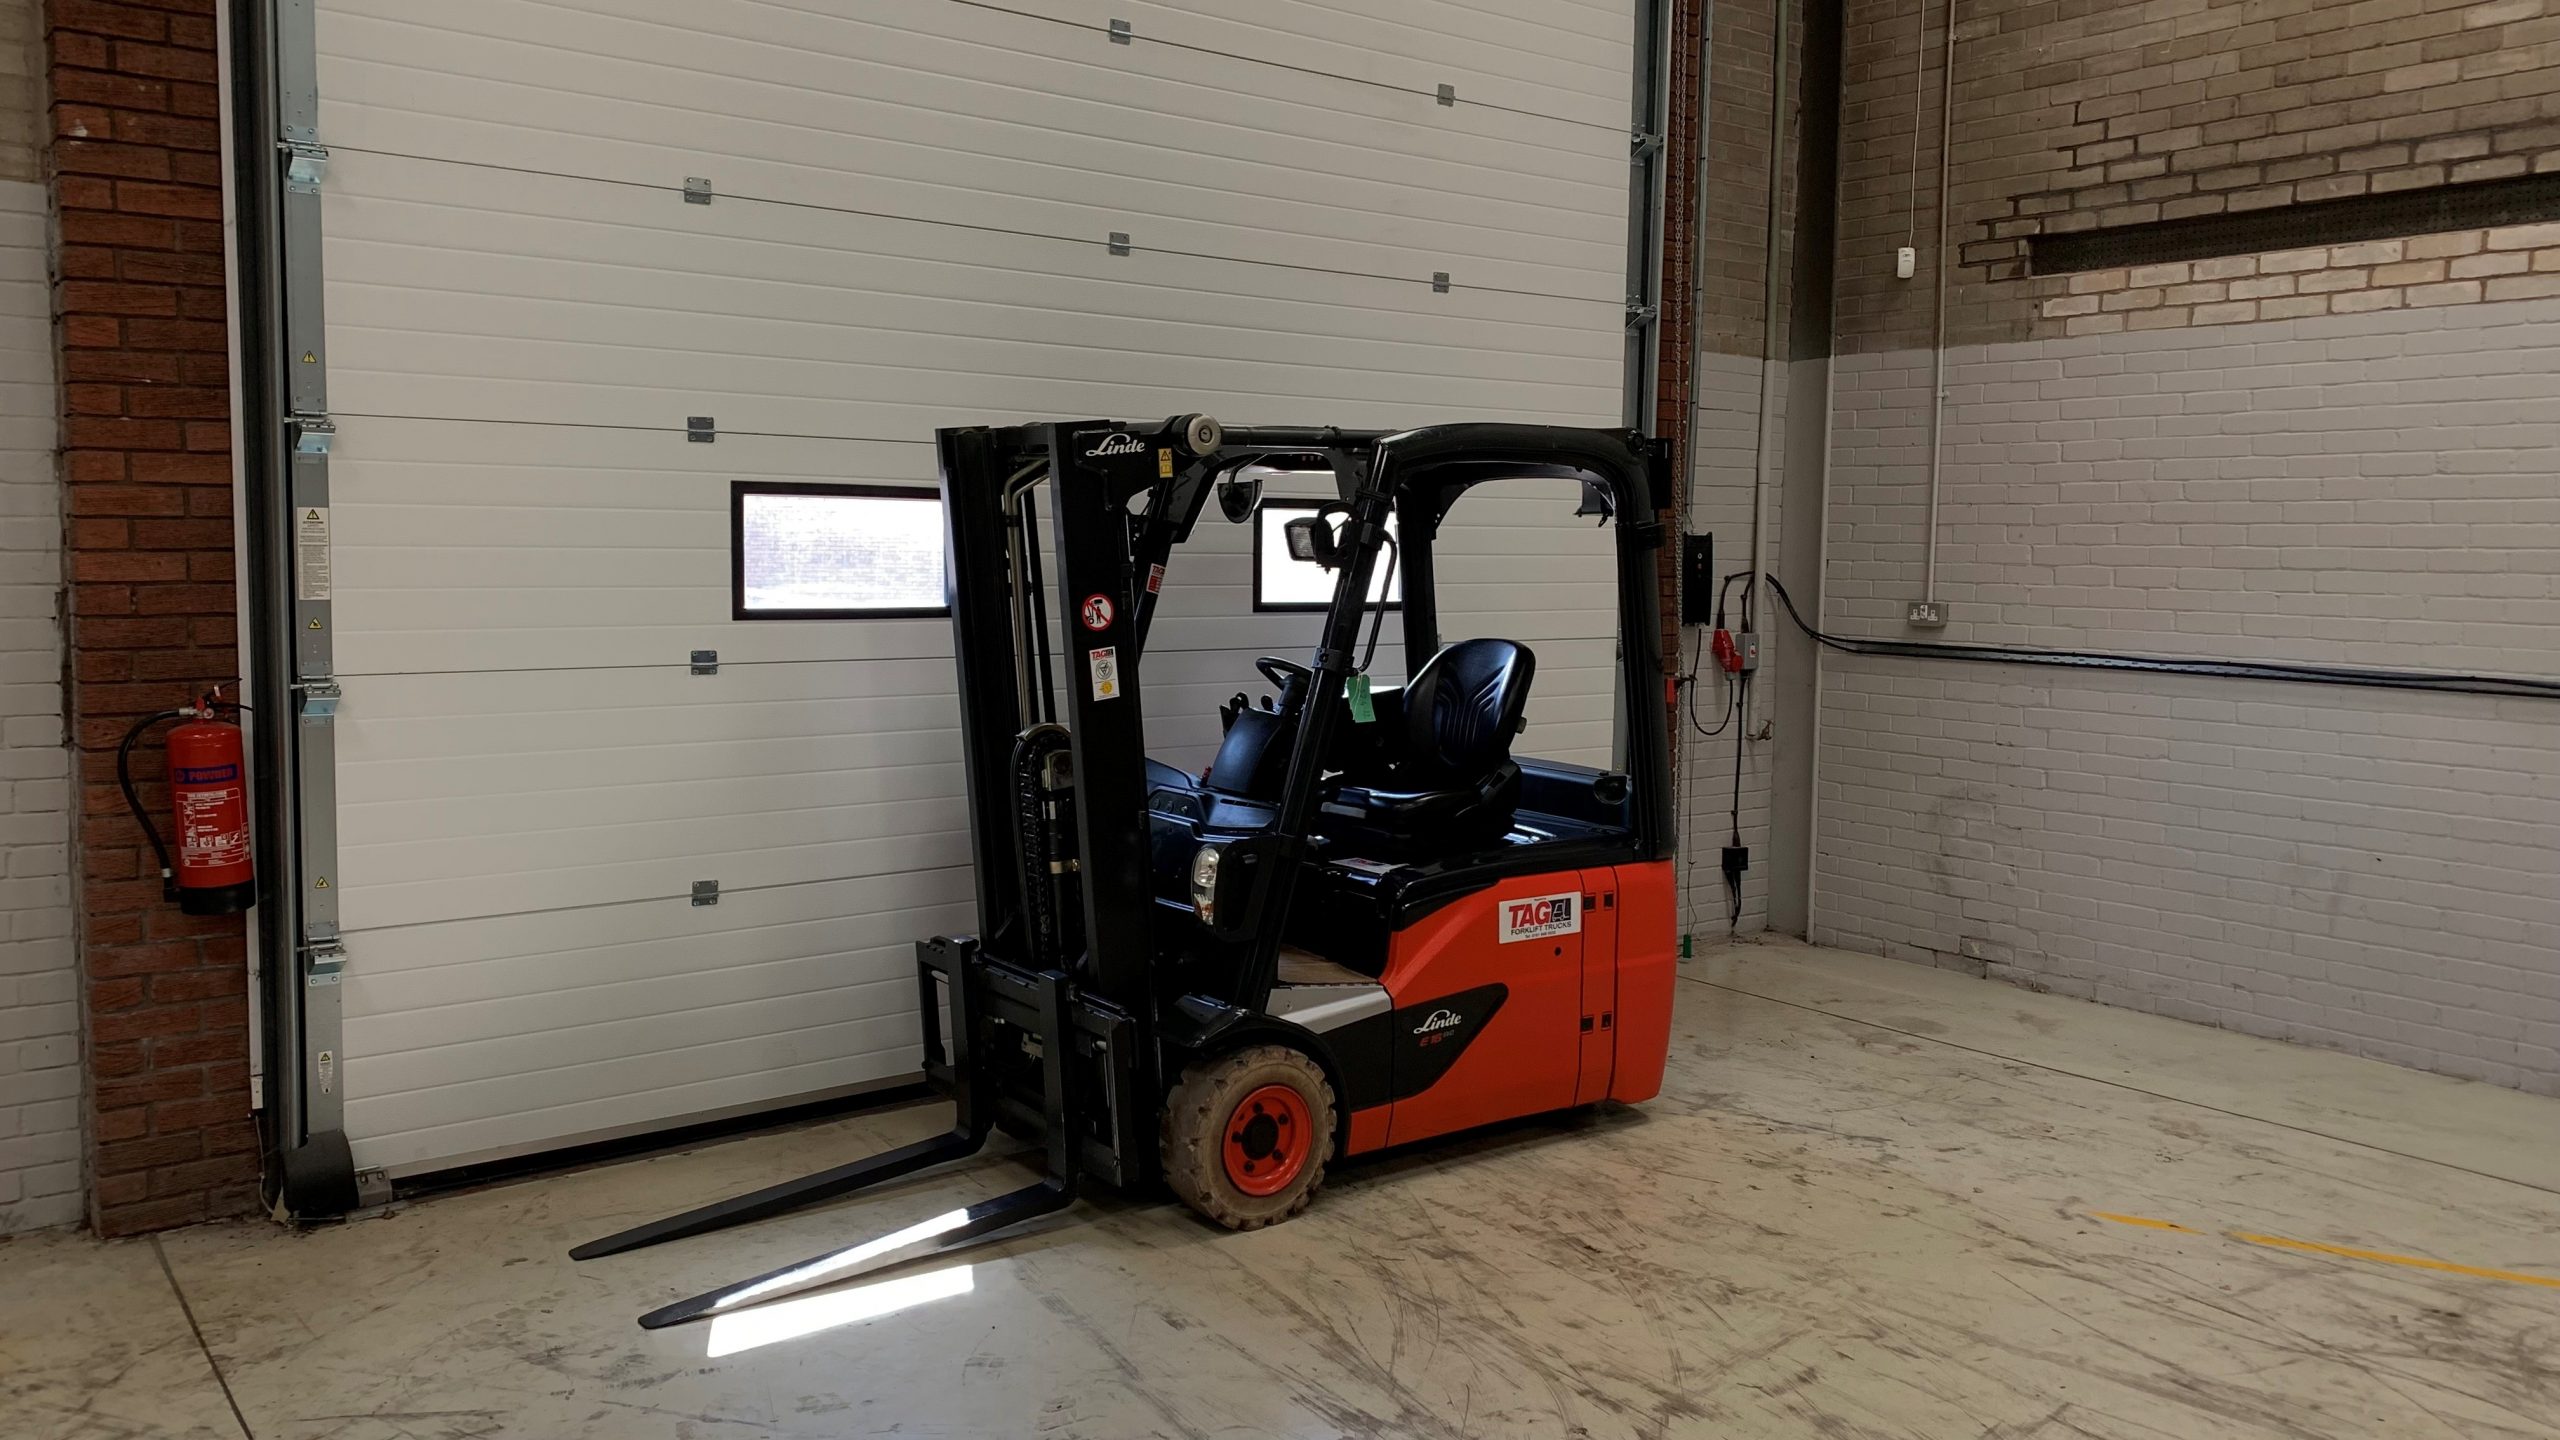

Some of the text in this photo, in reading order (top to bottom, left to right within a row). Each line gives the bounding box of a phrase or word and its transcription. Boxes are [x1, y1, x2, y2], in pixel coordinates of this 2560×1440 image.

[1086, 433, 1145, 456] Linde
[1509, 901, 1552, 928] TAG
[1511, 925, 1545, 935] FORKLIFT
[1545, 920, 1572, 930] TRUCKS
[1413, 1009, 1462, 1034] Linde
